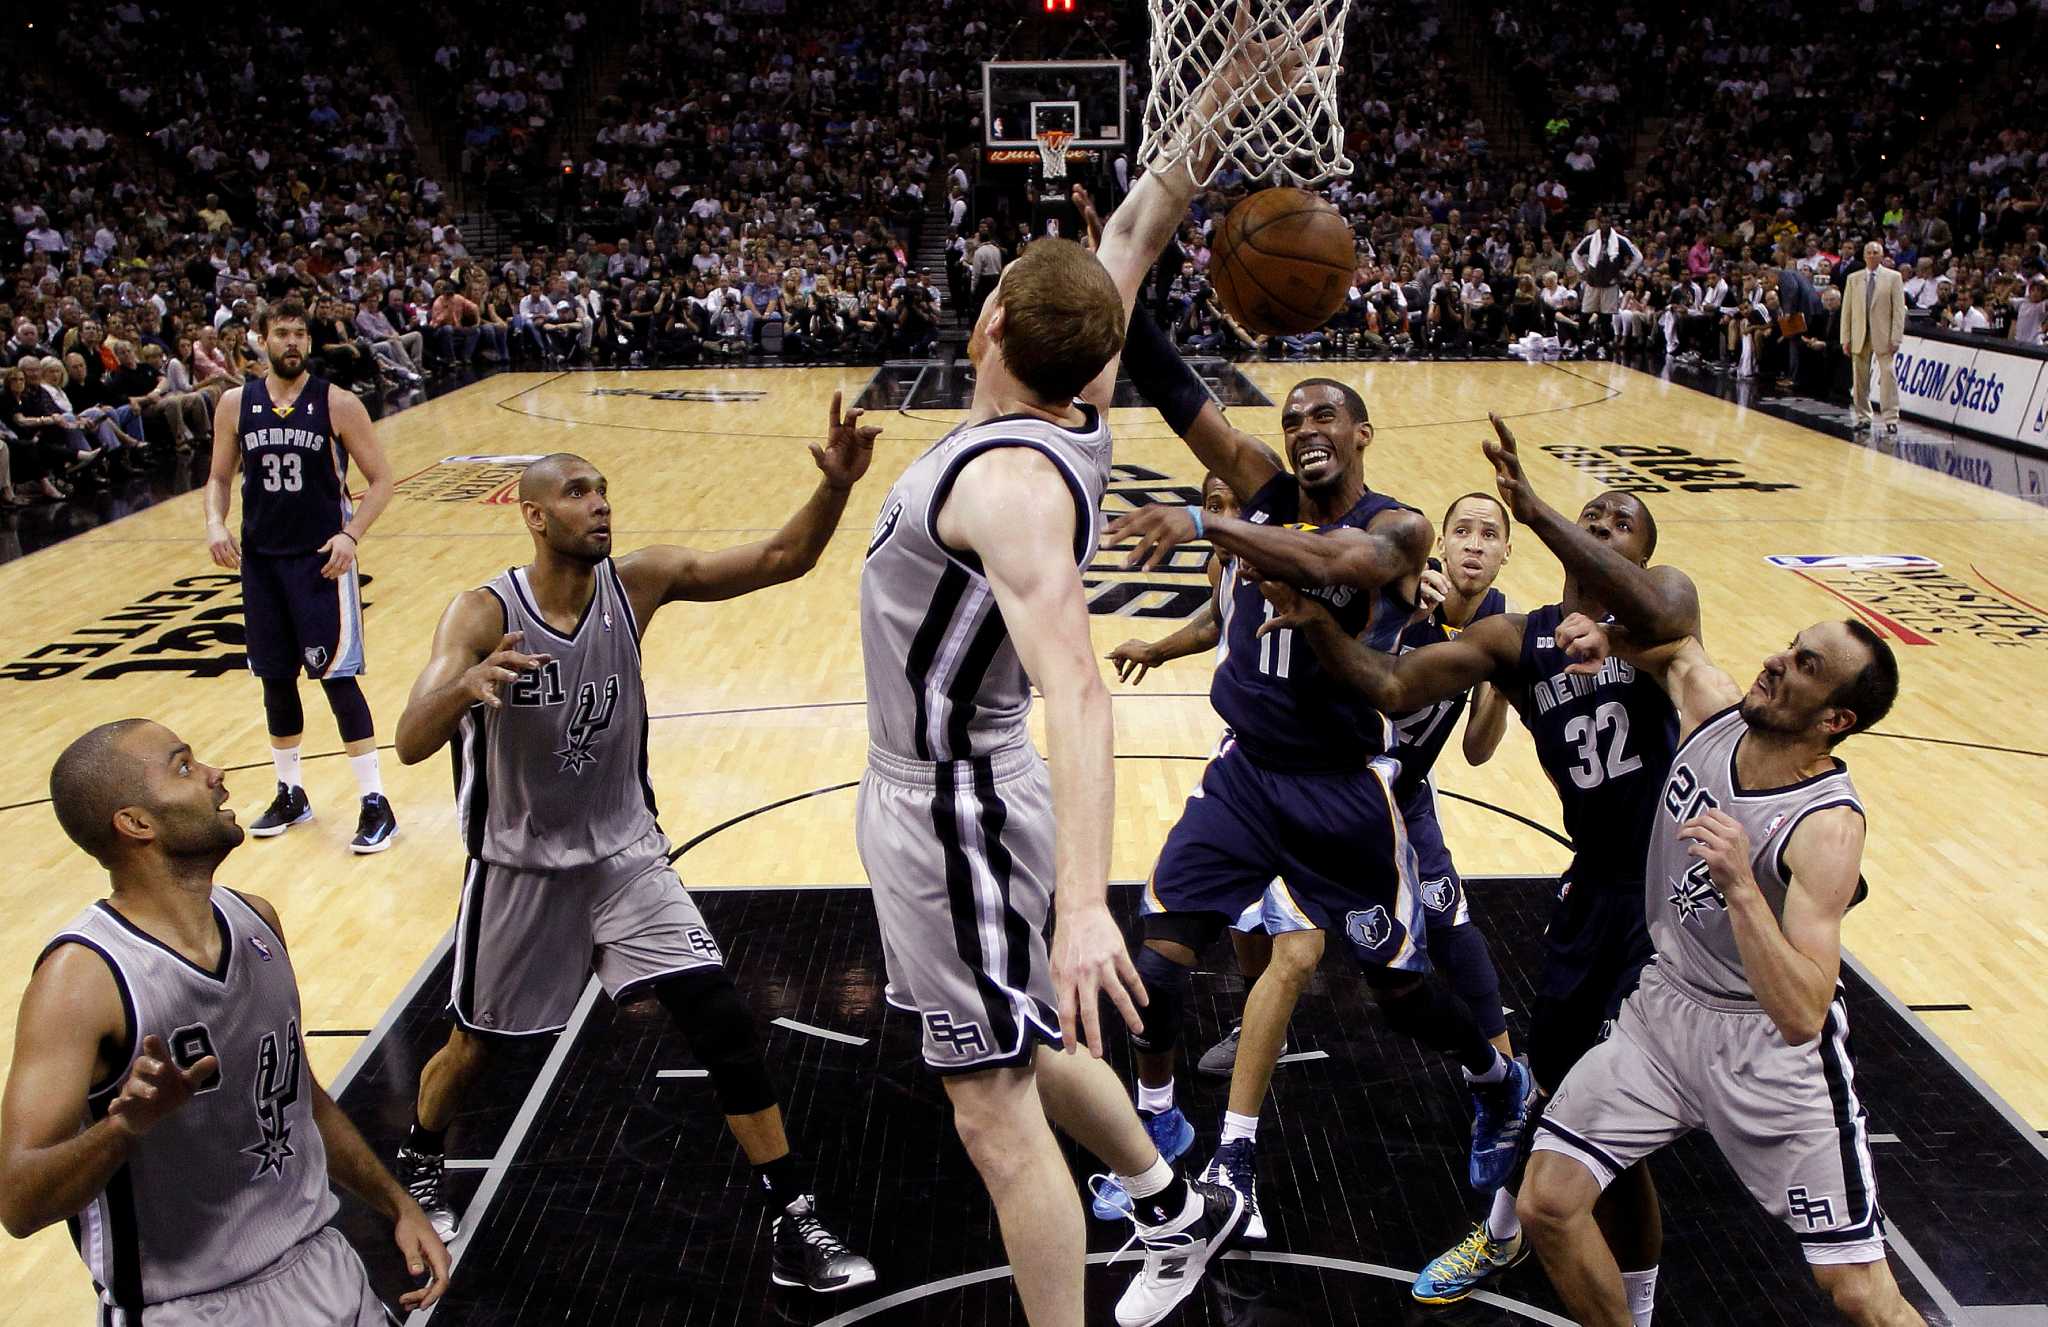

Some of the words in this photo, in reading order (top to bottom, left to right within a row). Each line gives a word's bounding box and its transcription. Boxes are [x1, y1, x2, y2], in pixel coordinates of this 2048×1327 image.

[244, 428, 324, 451] MEMPHIS
[261, 453, 303, 492] 33
[1539, 445, 1671, 493] CENTER
[1600, 445, 1802, 493] at&t
[1258, 598, 1293, 679] 11
[511, 659, 567, 707] 21
[1564, 701, 1643, 789] 32
[924, 1010, 989, 1056] SA
[1786, 1185, 1837, 1231] SA
